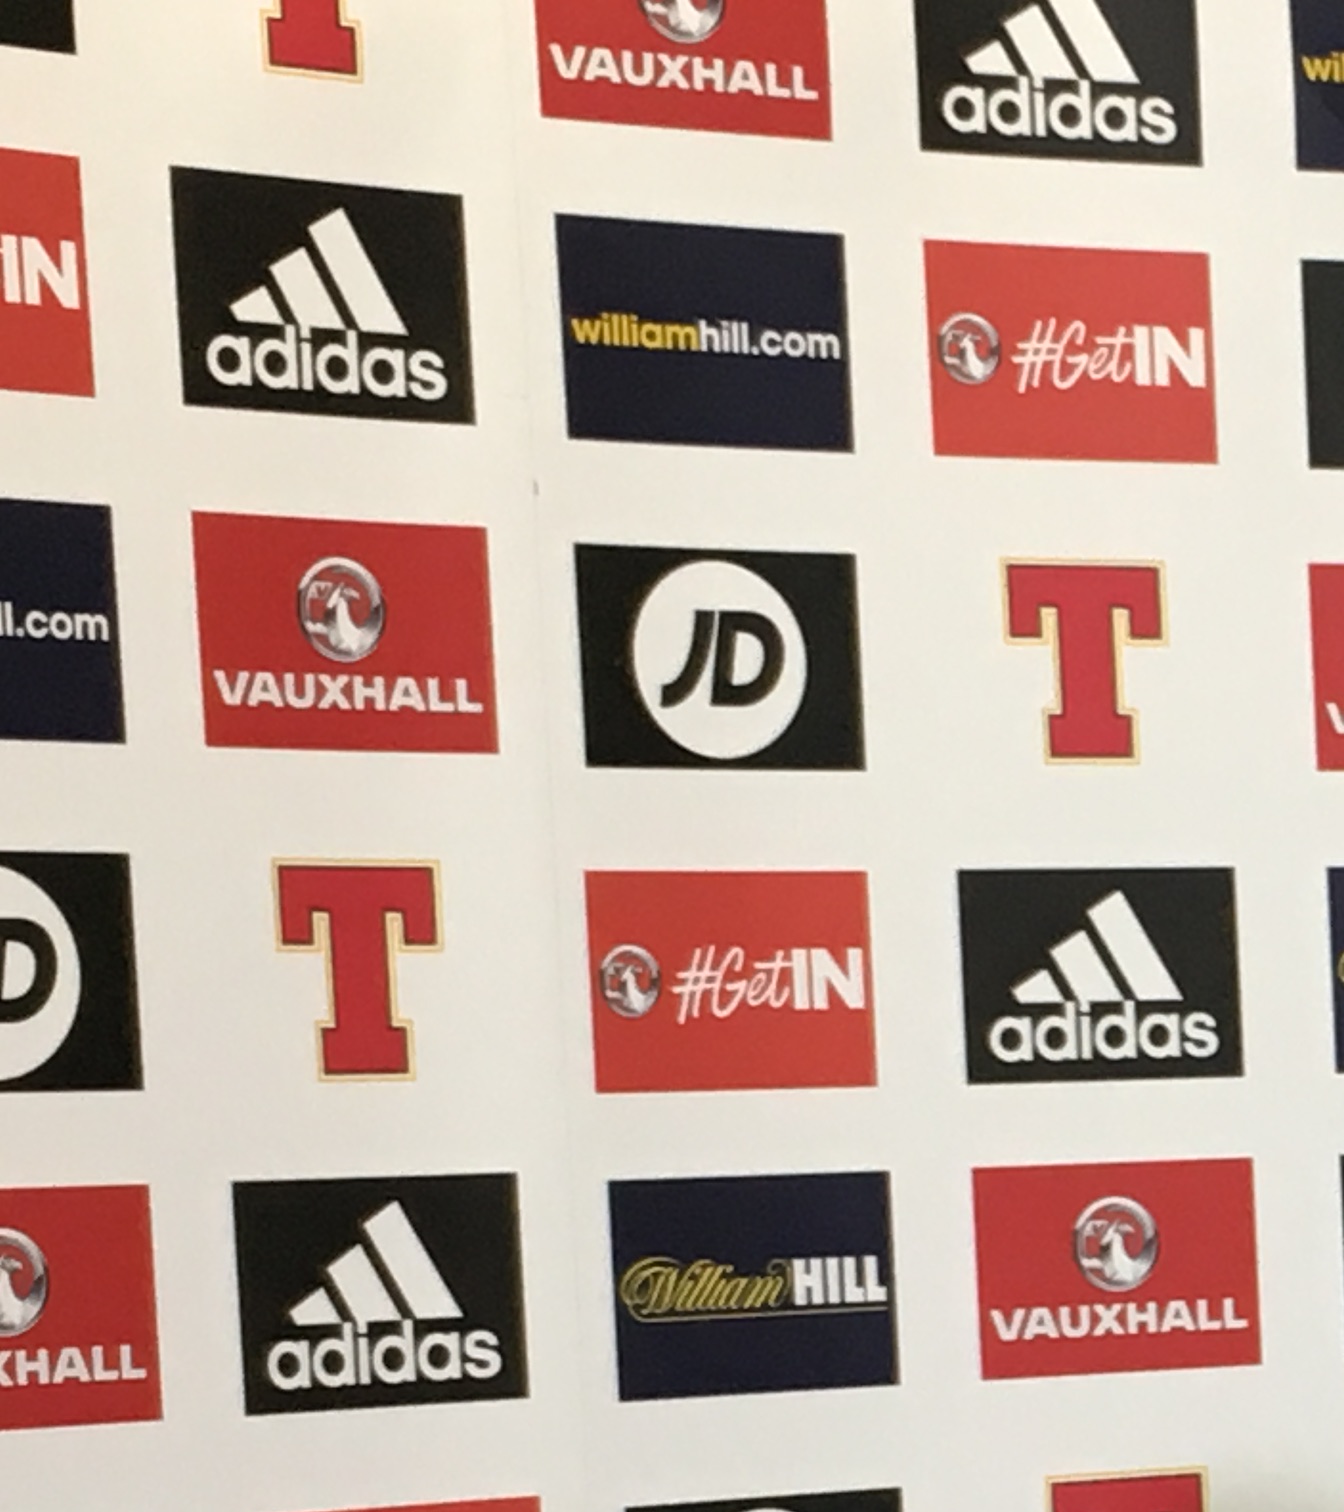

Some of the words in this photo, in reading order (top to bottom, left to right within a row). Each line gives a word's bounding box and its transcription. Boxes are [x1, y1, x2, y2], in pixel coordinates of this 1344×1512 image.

[550, 43, 818, 101] VAUXHALL
[942, 76, 1177, 145] adidas
[205, 329, 448, 400] adidas
[571, 315, 841, 360] williamhill.com
[1011, 318, 1206, 393] #GetIN
[213, 670, 483, 713] VAUXHALL
[659, 609, 785, 708] JD
[1001, 558, 1169, 765] T
[0, 917, 58, 1024] D
[272, 859, 444, 1082] T
[672, 946, 865, 1024] #GetIN
[990, 1003, 1219, 1064] adidas
[620, 1258, 791, 1322] William
[793, 1256, 886, 1305] HILL
[991, 1298, 1247, 1343] VAUXHALL
[0, 1345, 147, 1386] HALL
[268, 1322, 502, 1389] adidas
